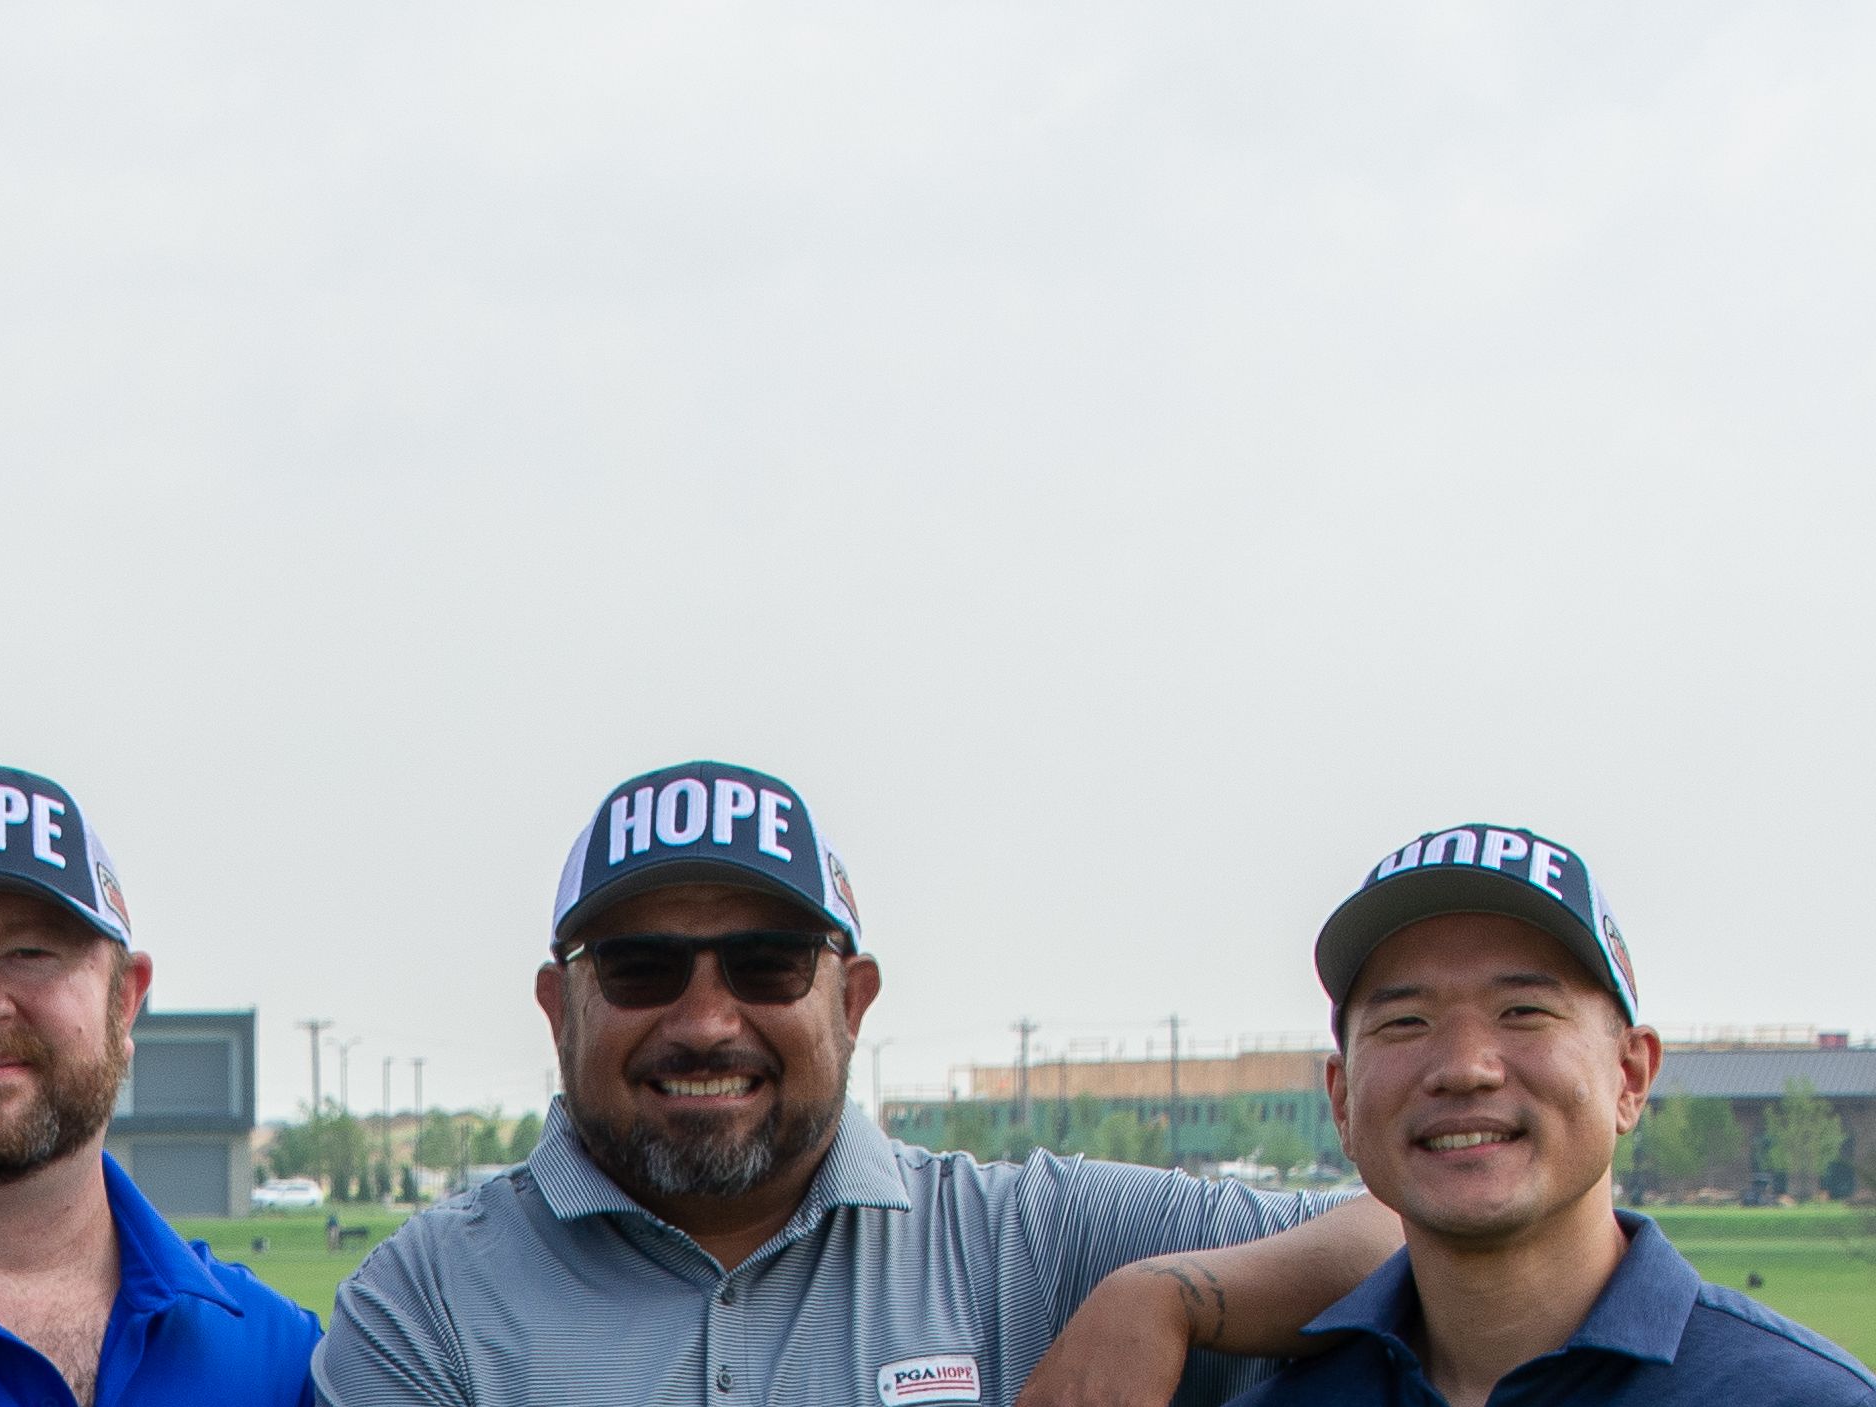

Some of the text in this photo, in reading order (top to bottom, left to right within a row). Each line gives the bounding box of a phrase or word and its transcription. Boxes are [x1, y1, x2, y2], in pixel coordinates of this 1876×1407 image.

[609, 777, 793, 867] HOPE
[895, 1366, 974, 1384] PGA HOPE
